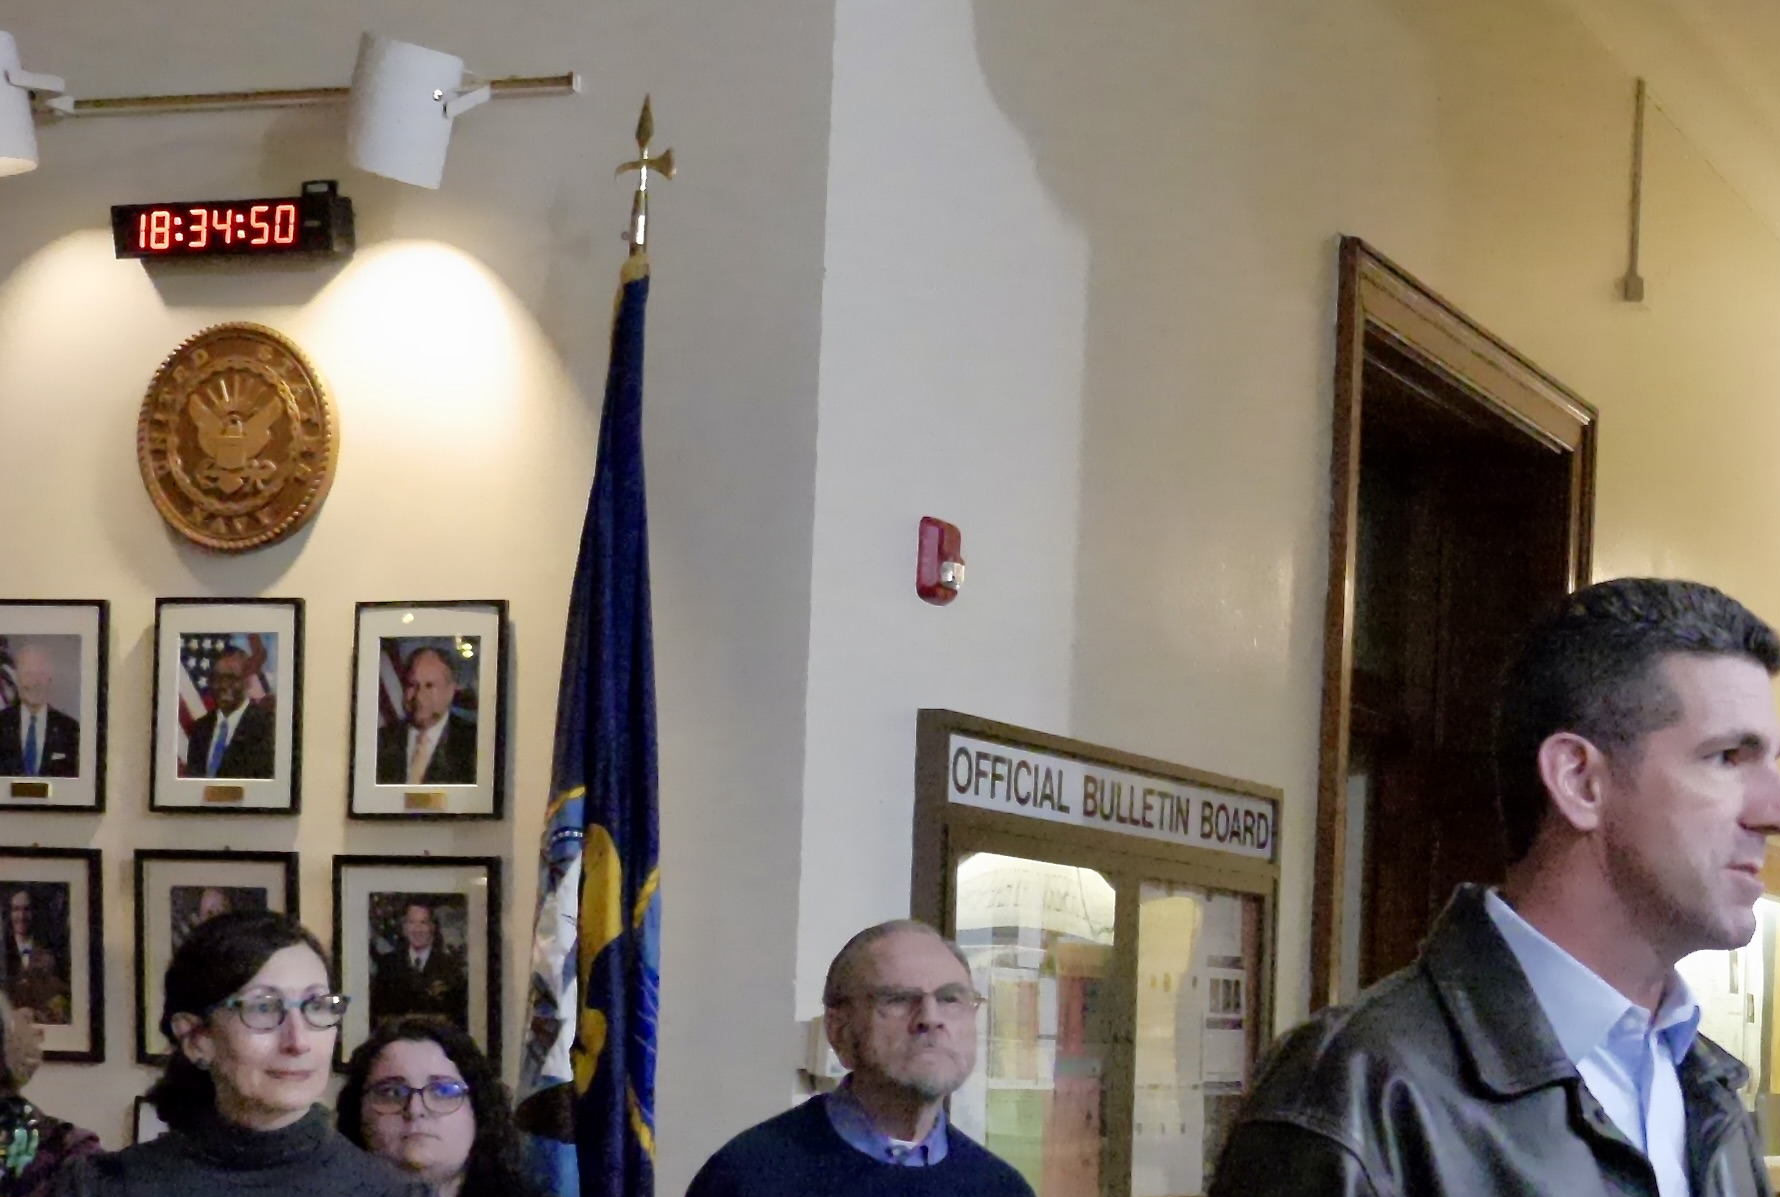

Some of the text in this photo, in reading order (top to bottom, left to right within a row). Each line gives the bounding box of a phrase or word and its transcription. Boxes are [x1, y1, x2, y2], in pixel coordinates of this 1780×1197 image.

[139, 205, 296, 249] 18:34:50
[952, 746, 1269, 850] OFFICIAL BULLETIN BOARD
